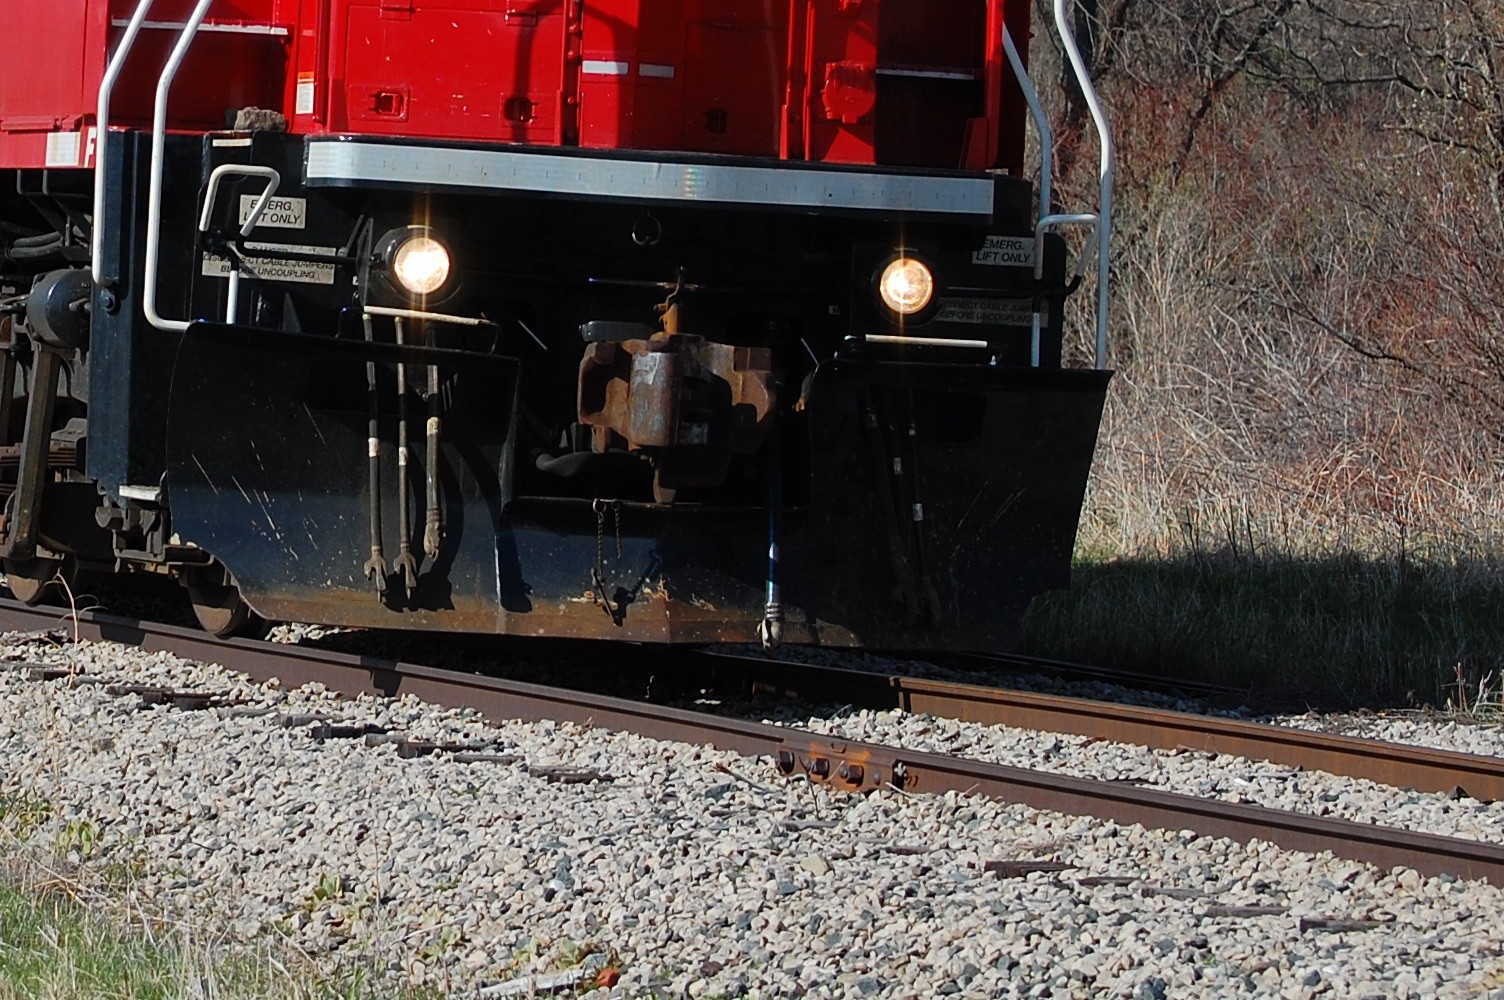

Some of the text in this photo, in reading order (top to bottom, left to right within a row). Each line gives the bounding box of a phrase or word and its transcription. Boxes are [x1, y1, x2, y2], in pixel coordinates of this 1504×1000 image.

[250, 199, 294, 212] EERG.
[270, 212, 301, 225] ONLY
[976, 250, 1031, 264] LIFT ONLY
[257, 265, 316, 280] UNCOUPLING
